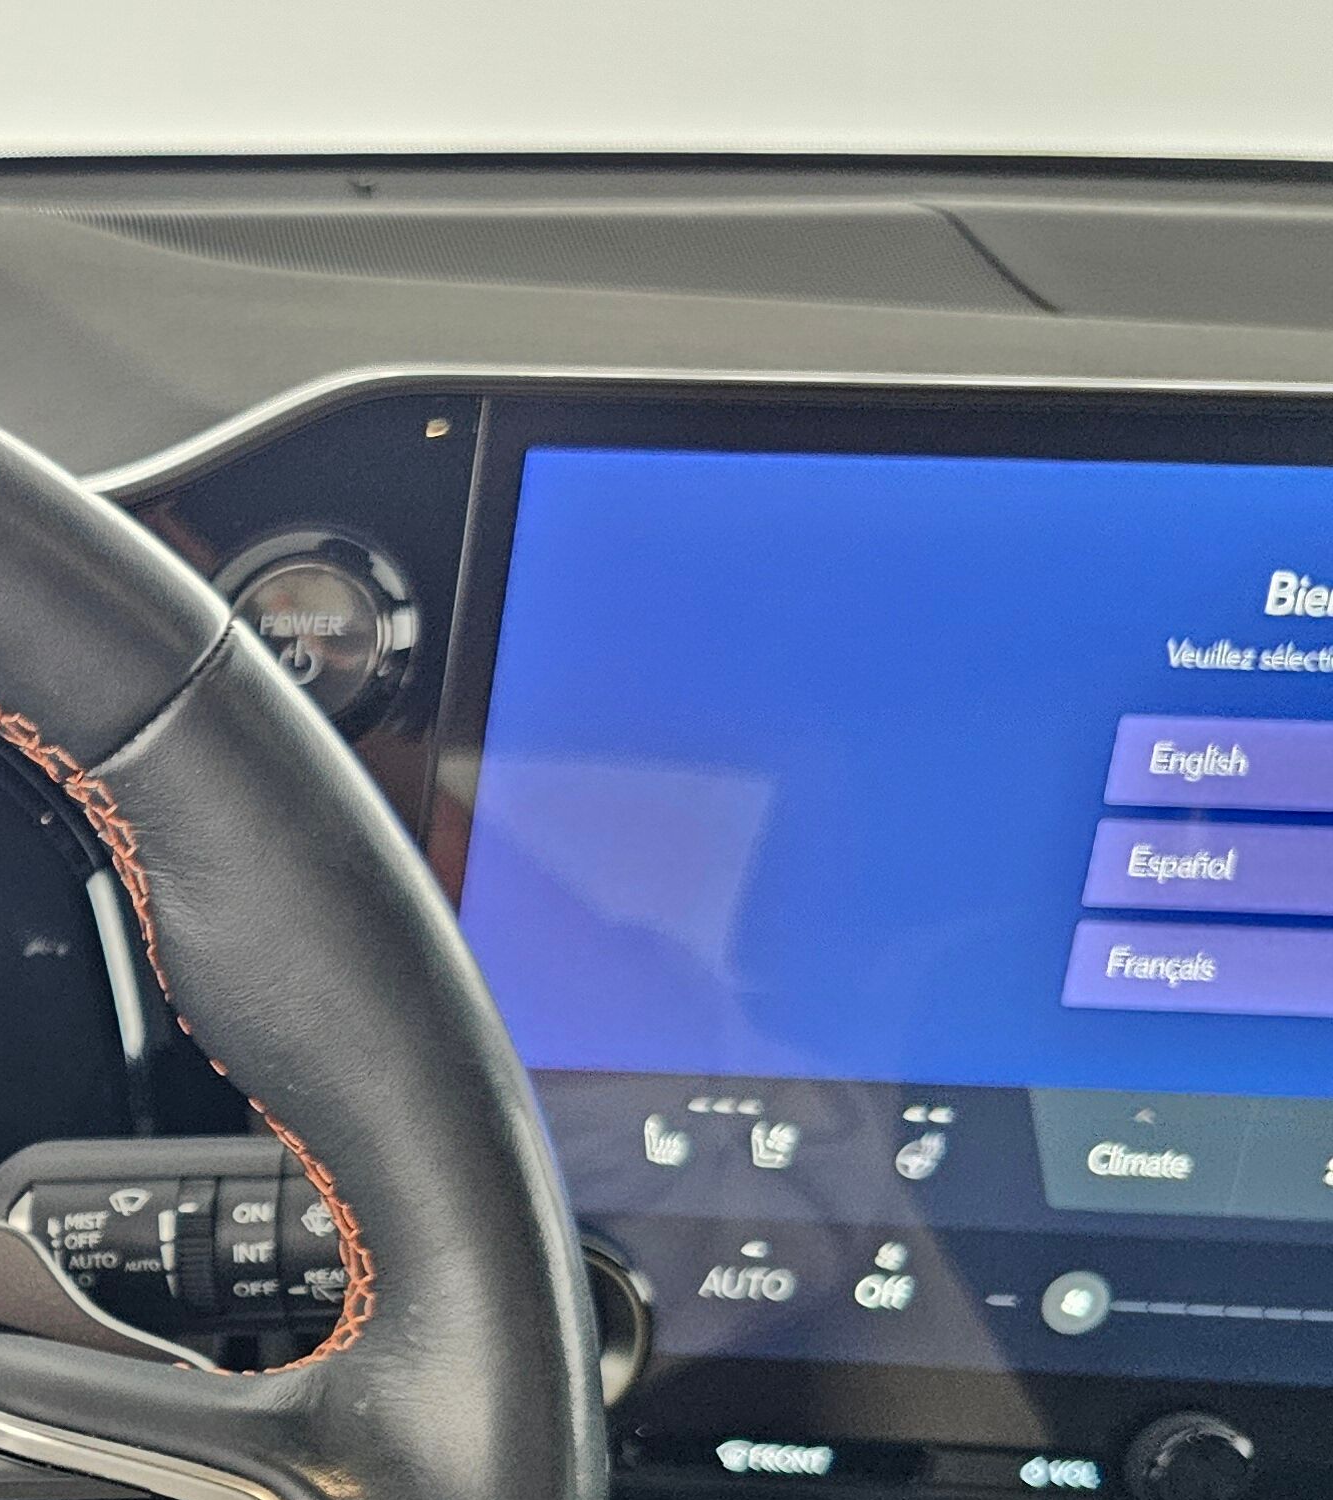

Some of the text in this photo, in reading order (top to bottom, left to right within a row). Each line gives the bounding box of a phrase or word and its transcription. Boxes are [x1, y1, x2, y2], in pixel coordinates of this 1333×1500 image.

[1264, 570, 1333, 618] Bie
[259, 613, 345, 636] POWER
[1167, 637, 1255, 671] Veuillez
[1149, 742, 1249, 782] English
[1128, 843, 1238, 884] Español
[1106, 945, 1218, 987] Français
[1088, 1142, 1194, 1180] Climate
[233, 1202, 275, 1224] ON
[64, 1230, 103, 1250] OFF
[233, 1240, 275, 1263] INT
[69, 1252, 118, 1270] AUTO
[233, 1279, 278, 1298] OFF
[304, 1268, 345, 1285] REA
[697, 1265, 796, 1302] AUTO
